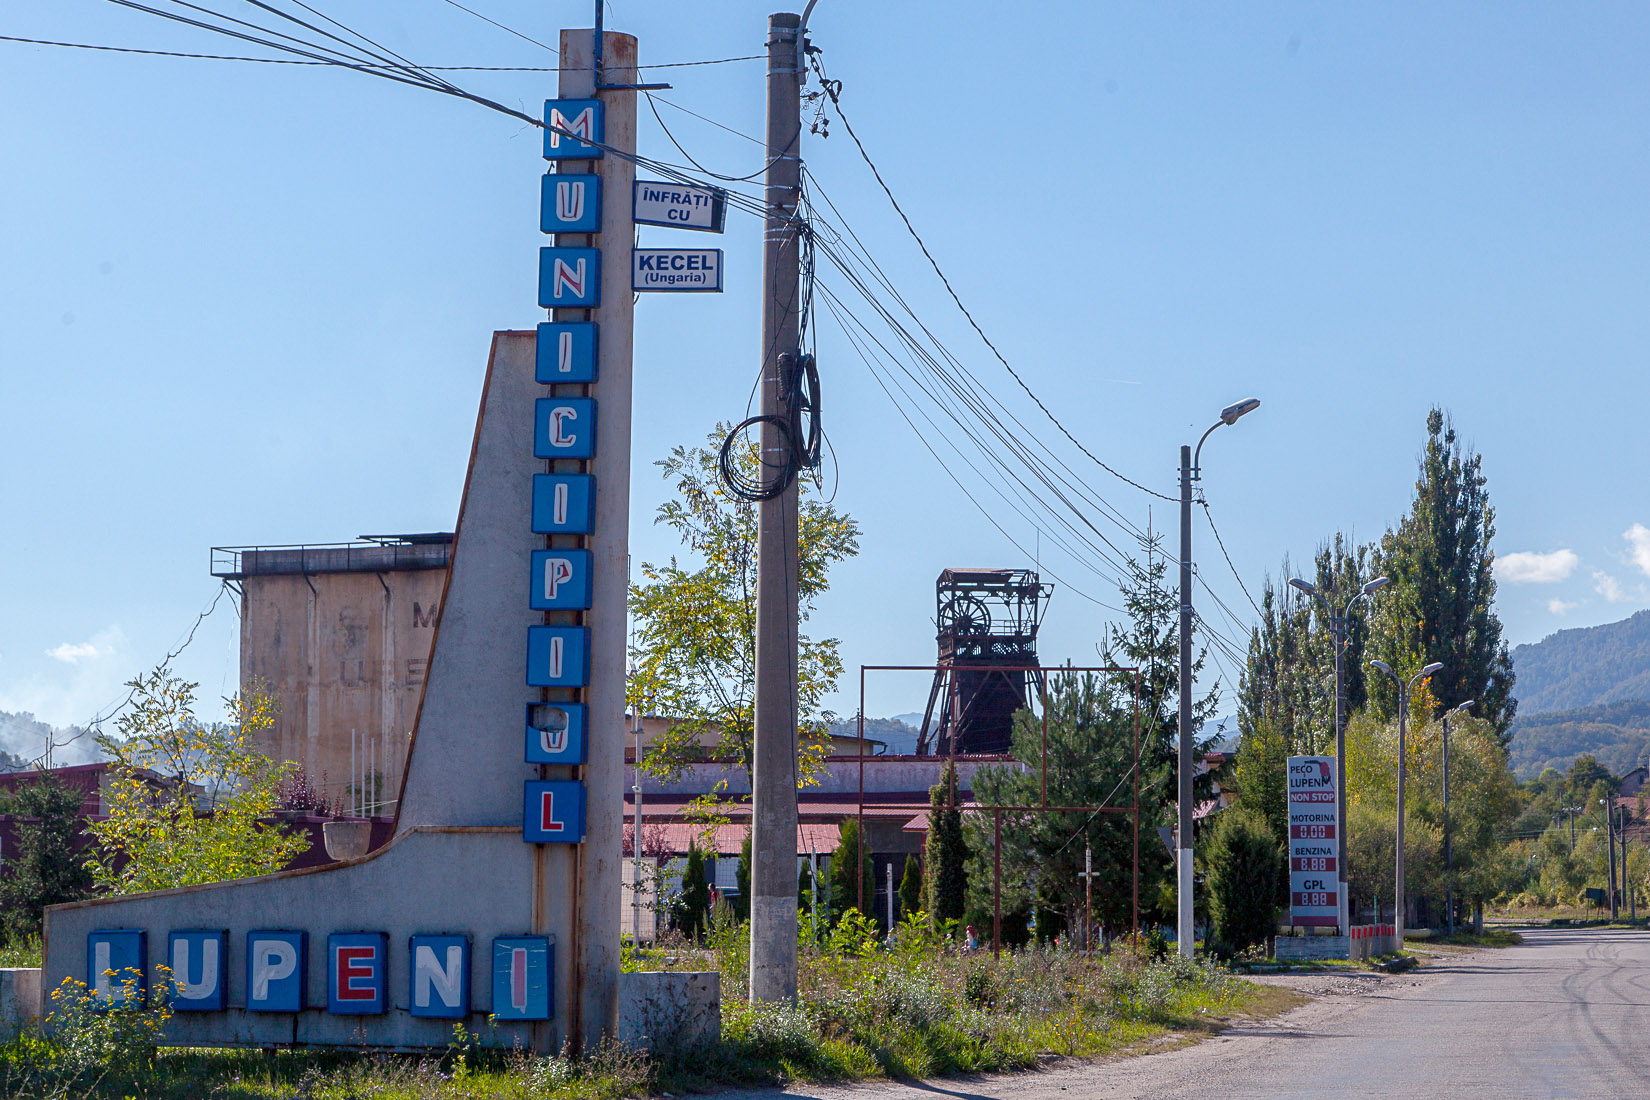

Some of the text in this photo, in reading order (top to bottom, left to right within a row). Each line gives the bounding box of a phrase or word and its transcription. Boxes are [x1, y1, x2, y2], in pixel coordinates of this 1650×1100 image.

[667, 208, 691, 221] CU
[639, 254, 714, 271] KECEL
[644, 272, 707, 285] (Ungaria)
[540, 106, 594, 832] MUNICIPIUL
[1290, 765, 1313, 774] PECO
[1290, 778, 1324, 787] LUPENI
[1290, 793, 1334, 801] NON STOP
[1291, 814, 1335, 823] MOTORINA
[1295, 847, 1332, 856] BENZINA
[1303, 879, 1326, 890] GPL
[95, 938, 528, 1012] LUPENI
